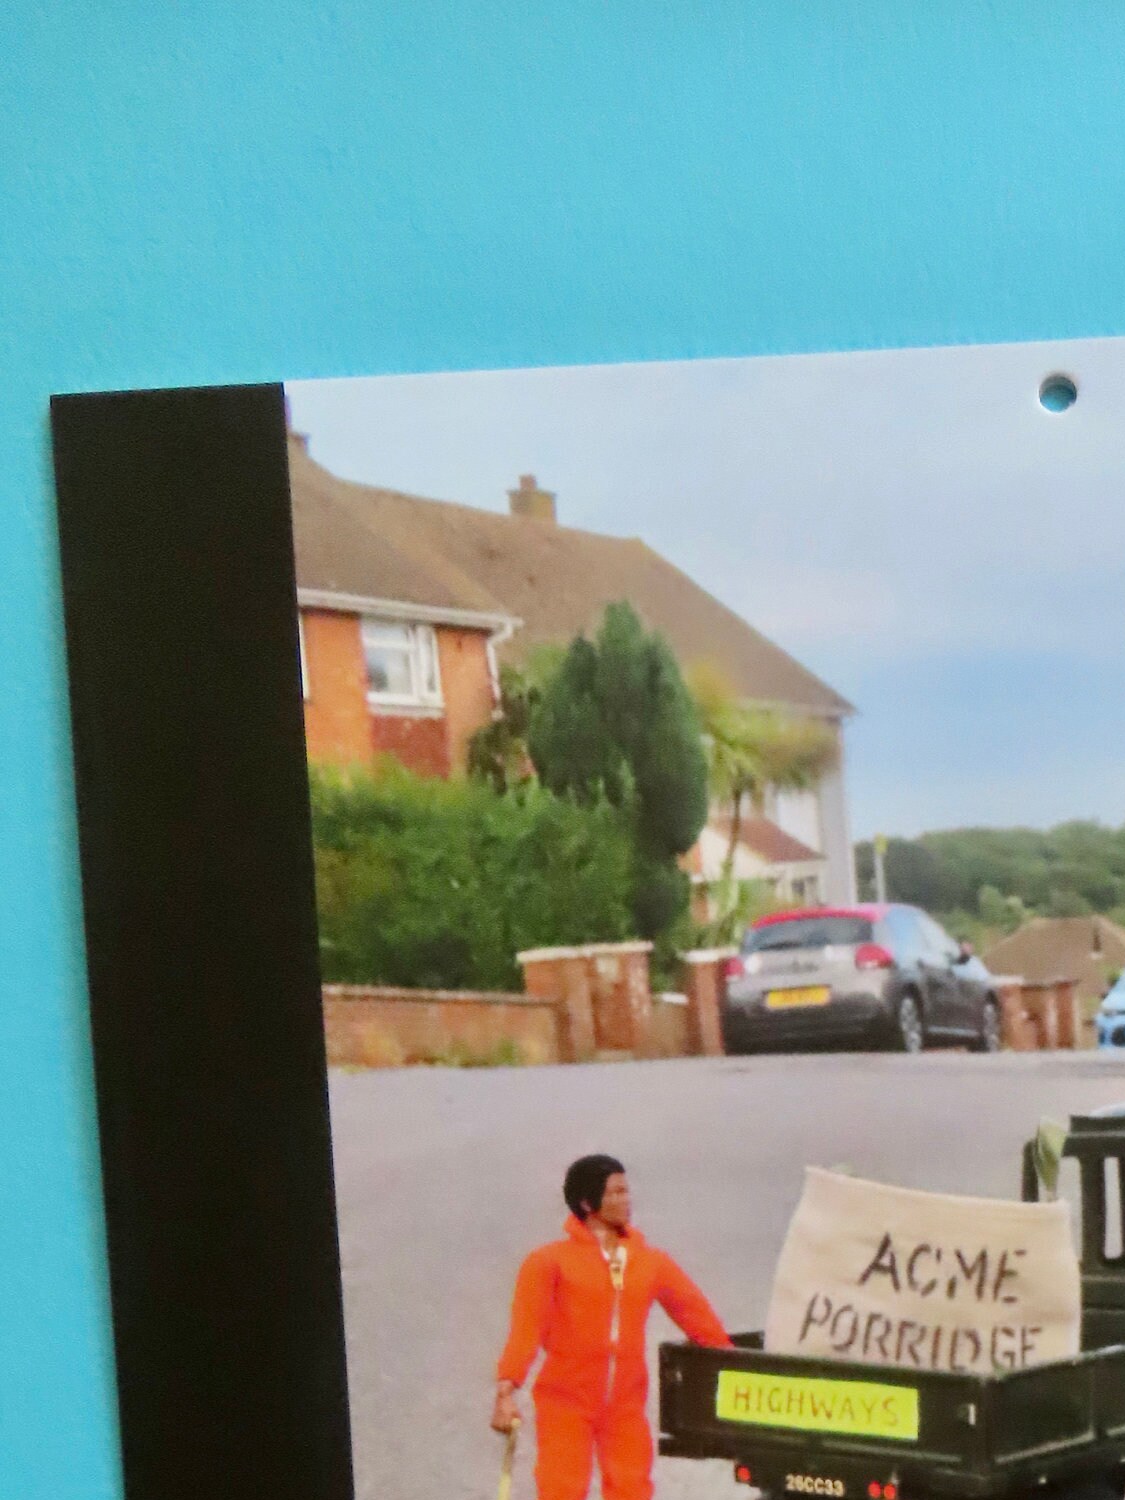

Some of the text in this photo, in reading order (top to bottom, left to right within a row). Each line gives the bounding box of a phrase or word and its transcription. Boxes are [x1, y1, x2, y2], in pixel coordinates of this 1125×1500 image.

[858, 1231, 1027, 1304] ACME
[798, 1292, 1042, 1373] PORRIDGE
[732, 1384, 900, 1428] HIGHWAYS
